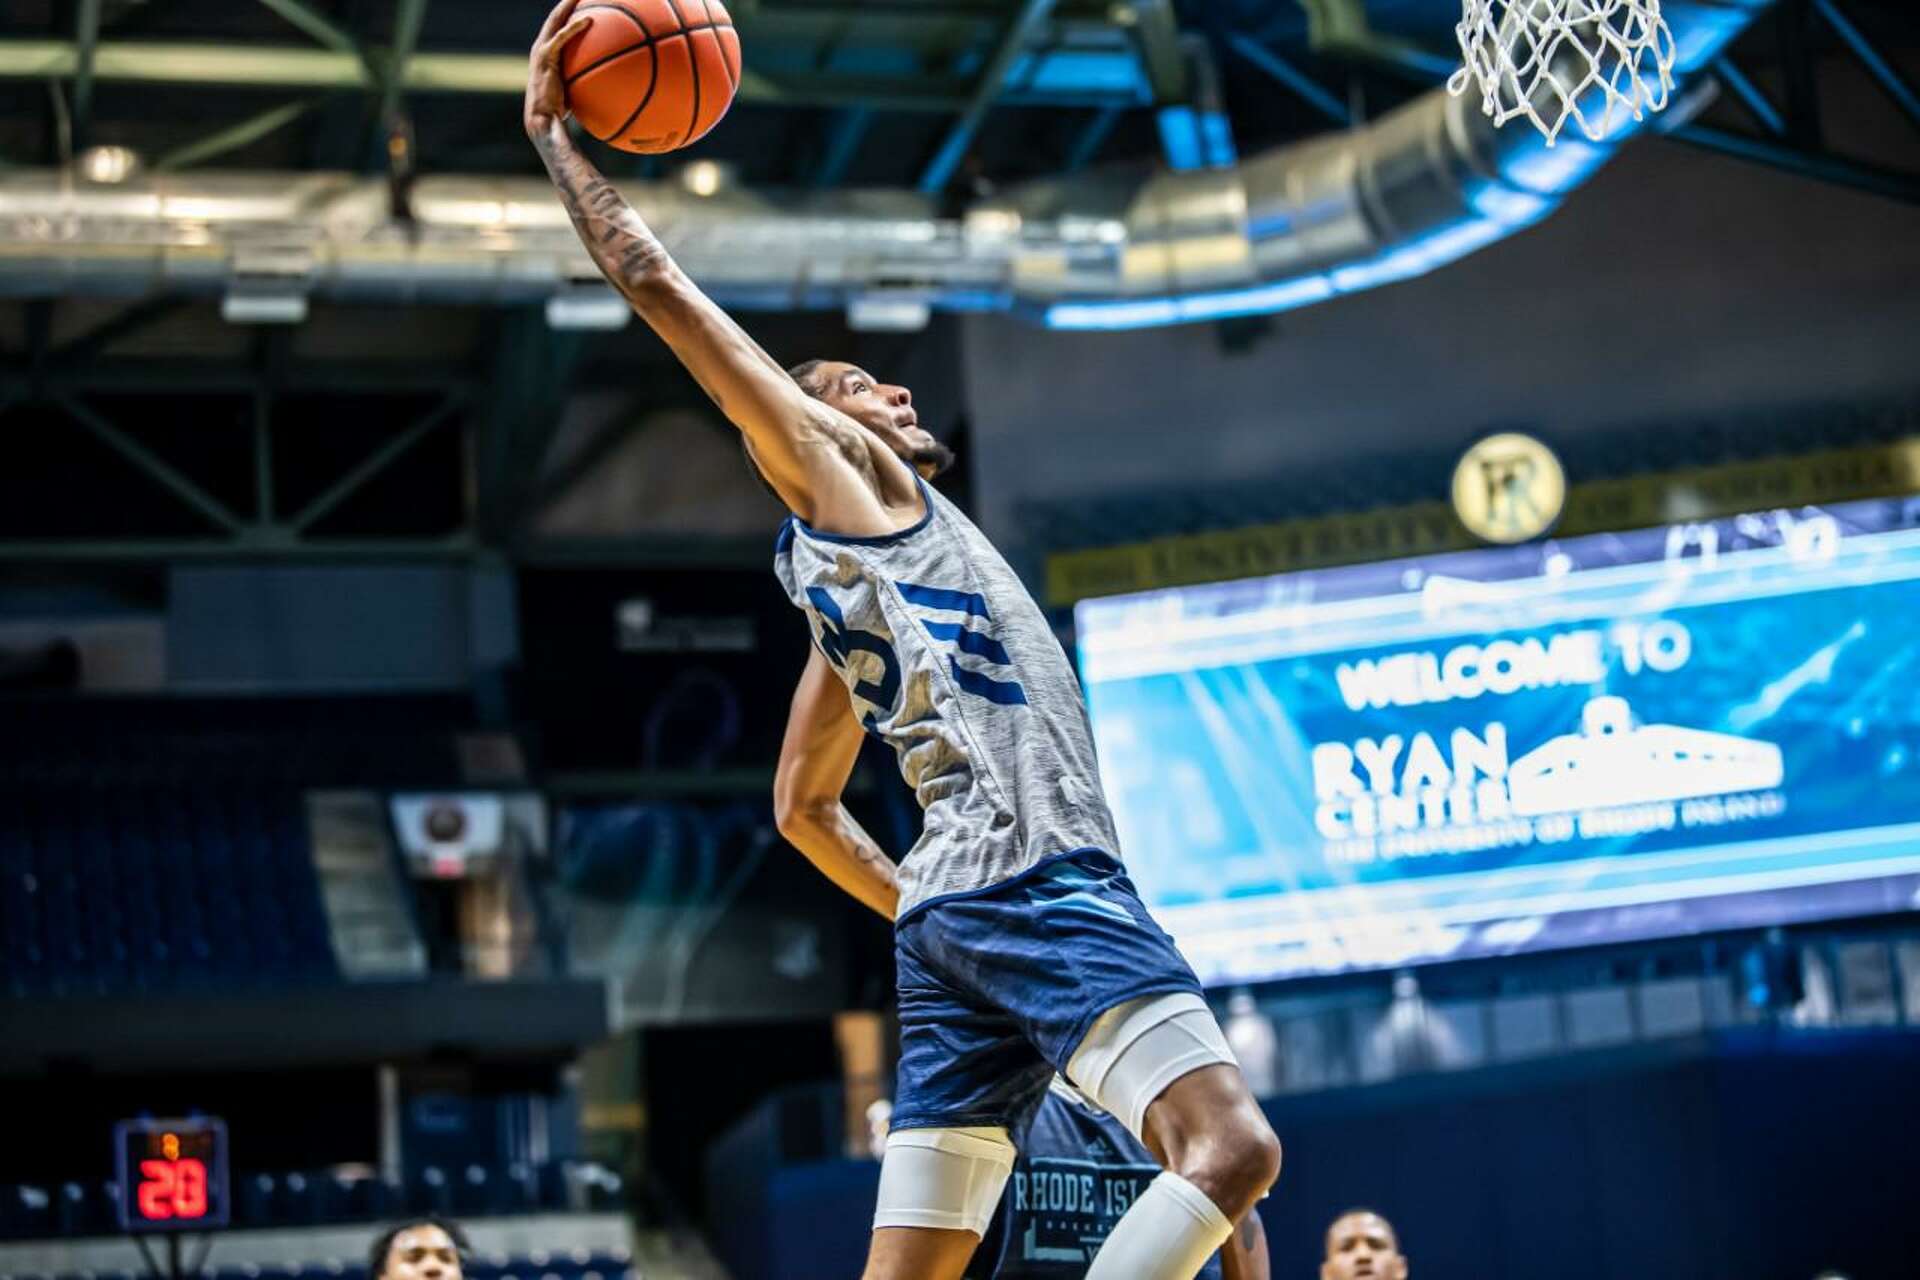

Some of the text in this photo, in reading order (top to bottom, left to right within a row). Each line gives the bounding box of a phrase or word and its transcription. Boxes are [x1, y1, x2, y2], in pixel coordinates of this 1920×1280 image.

[1336, 619, 1691, 711] WELCOME TO
[1312, 721, 1511, 799] RYAN
[138, 1158, 208, 1219] 20
[1015, 1170, 1094, 1214] RHODE
